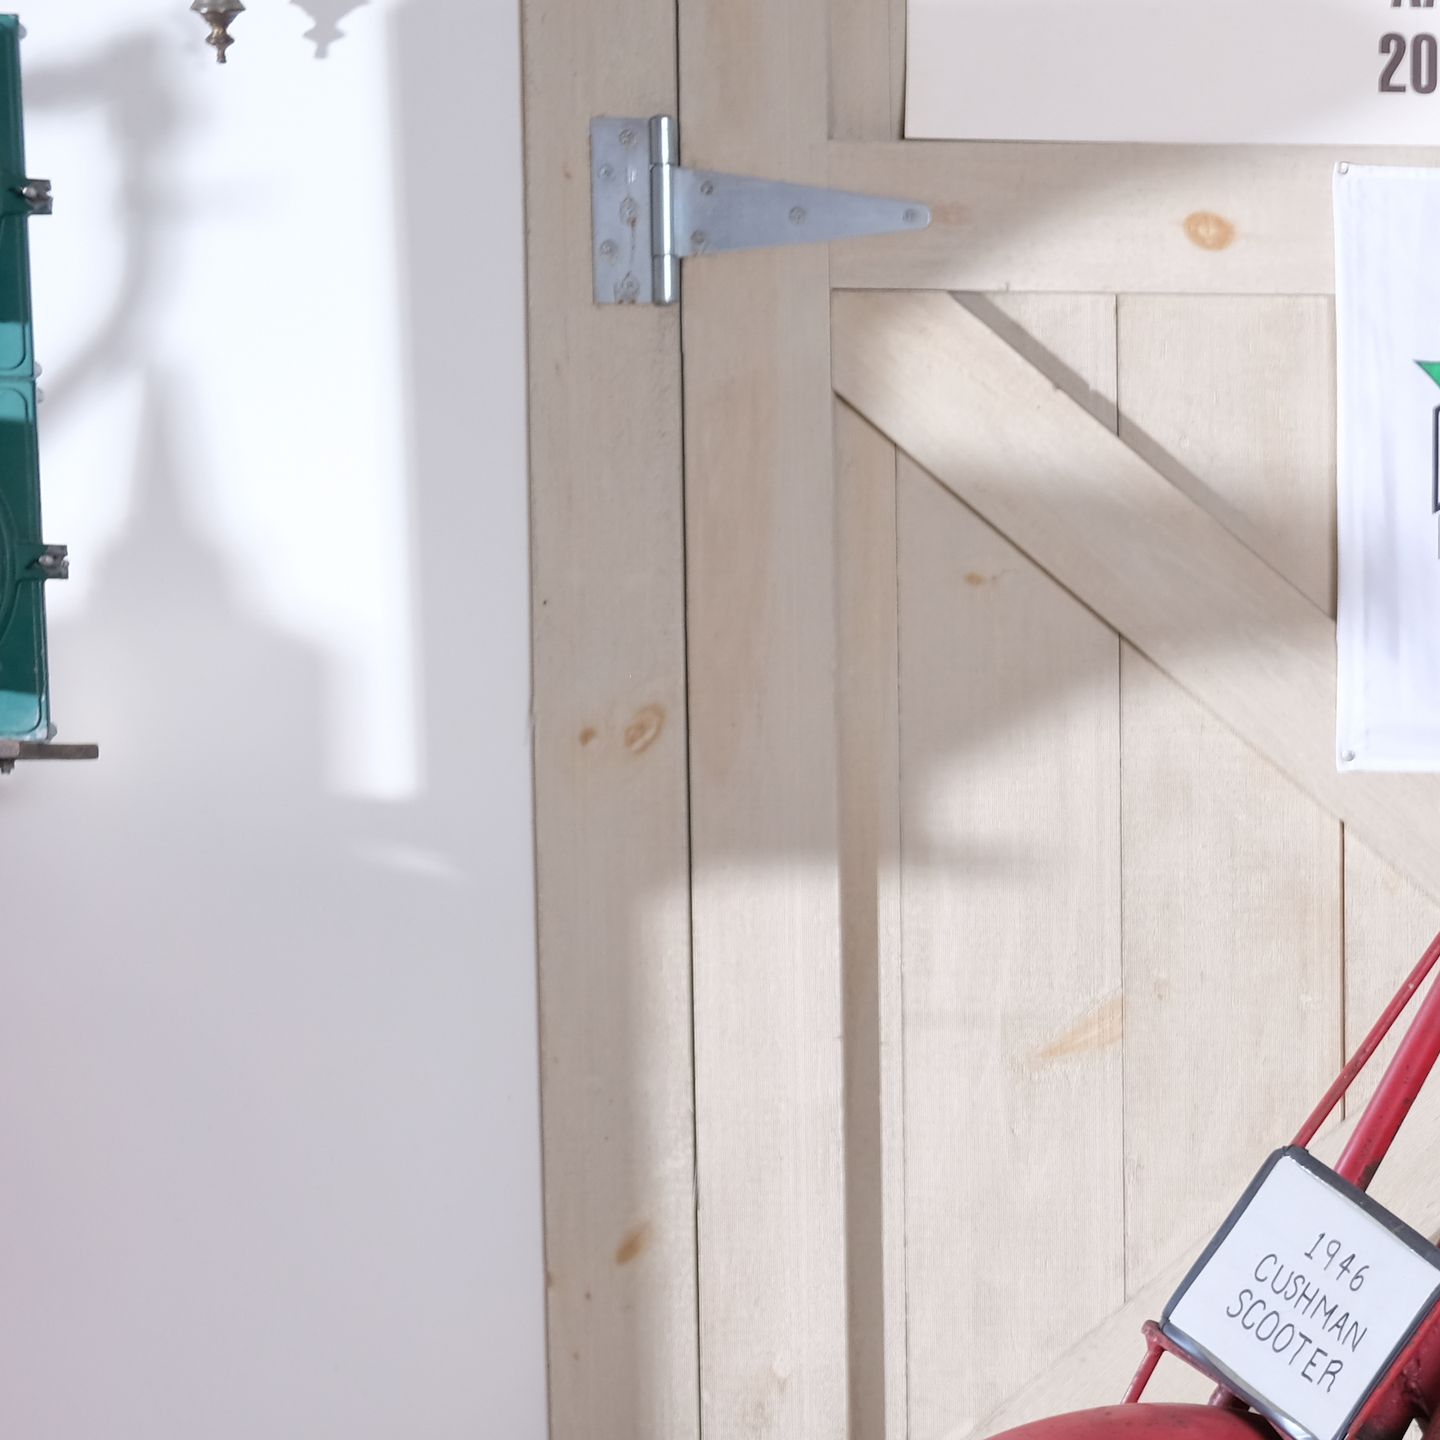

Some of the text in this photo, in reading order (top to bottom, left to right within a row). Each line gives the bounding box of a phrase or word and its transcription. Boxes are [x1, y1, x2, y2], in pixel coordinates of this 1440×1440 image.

[1254, 1253, 1368, 1353] CUSHMAN
[1304, 1232, 1370, 1292] 1946
[1226, 1288, 1343, 1393] SCOOTER
